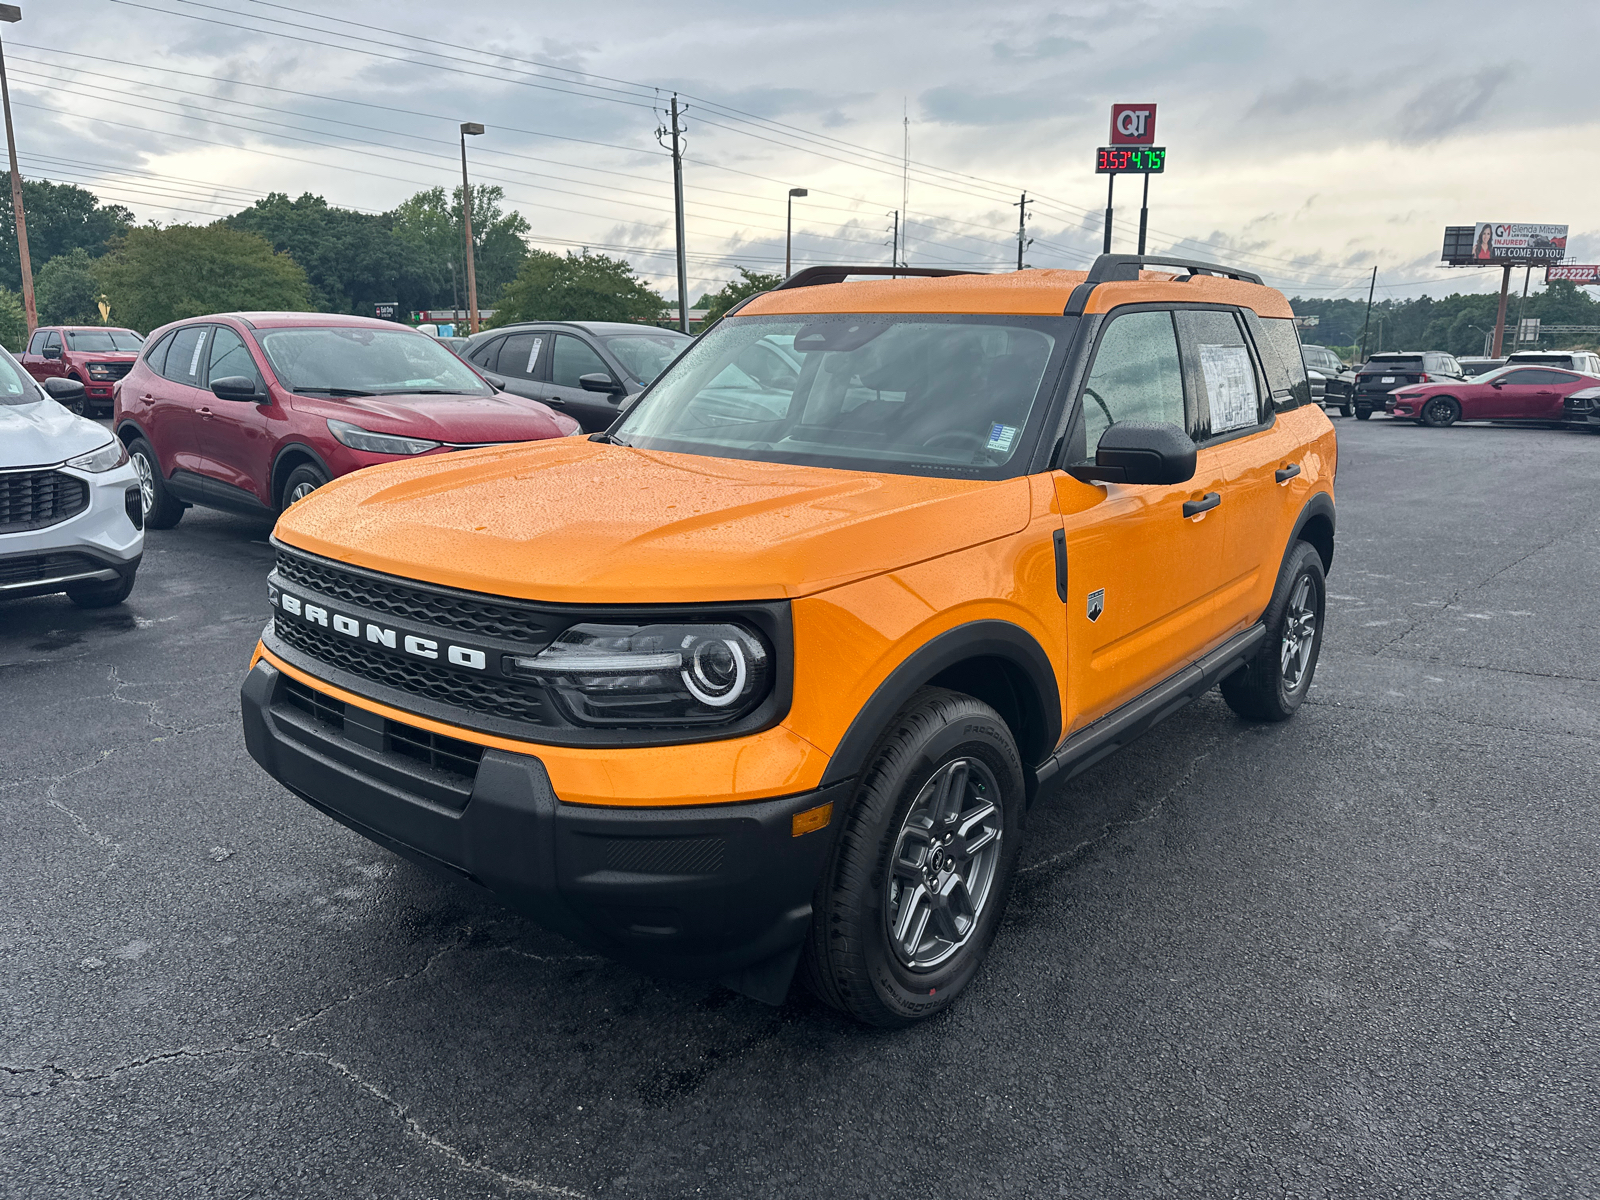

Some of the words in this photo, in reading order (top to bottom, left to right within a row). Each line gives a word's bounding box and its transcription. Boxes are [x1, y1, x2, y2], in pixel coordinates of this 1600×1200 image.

[1117, 110, 1150, 137] QT
[1511, 225, 1538, 233] Glenda
[1539, 226, 1568, 235] Mitchell
[1494, 248, 1507, 257] WE
[1507, 248, 1532, 257] COME
[1533, 249, 1544, 257] TO
[1545, 249, 1565, 258] YOU!
[281, 593, 486, 670] BRONCO
